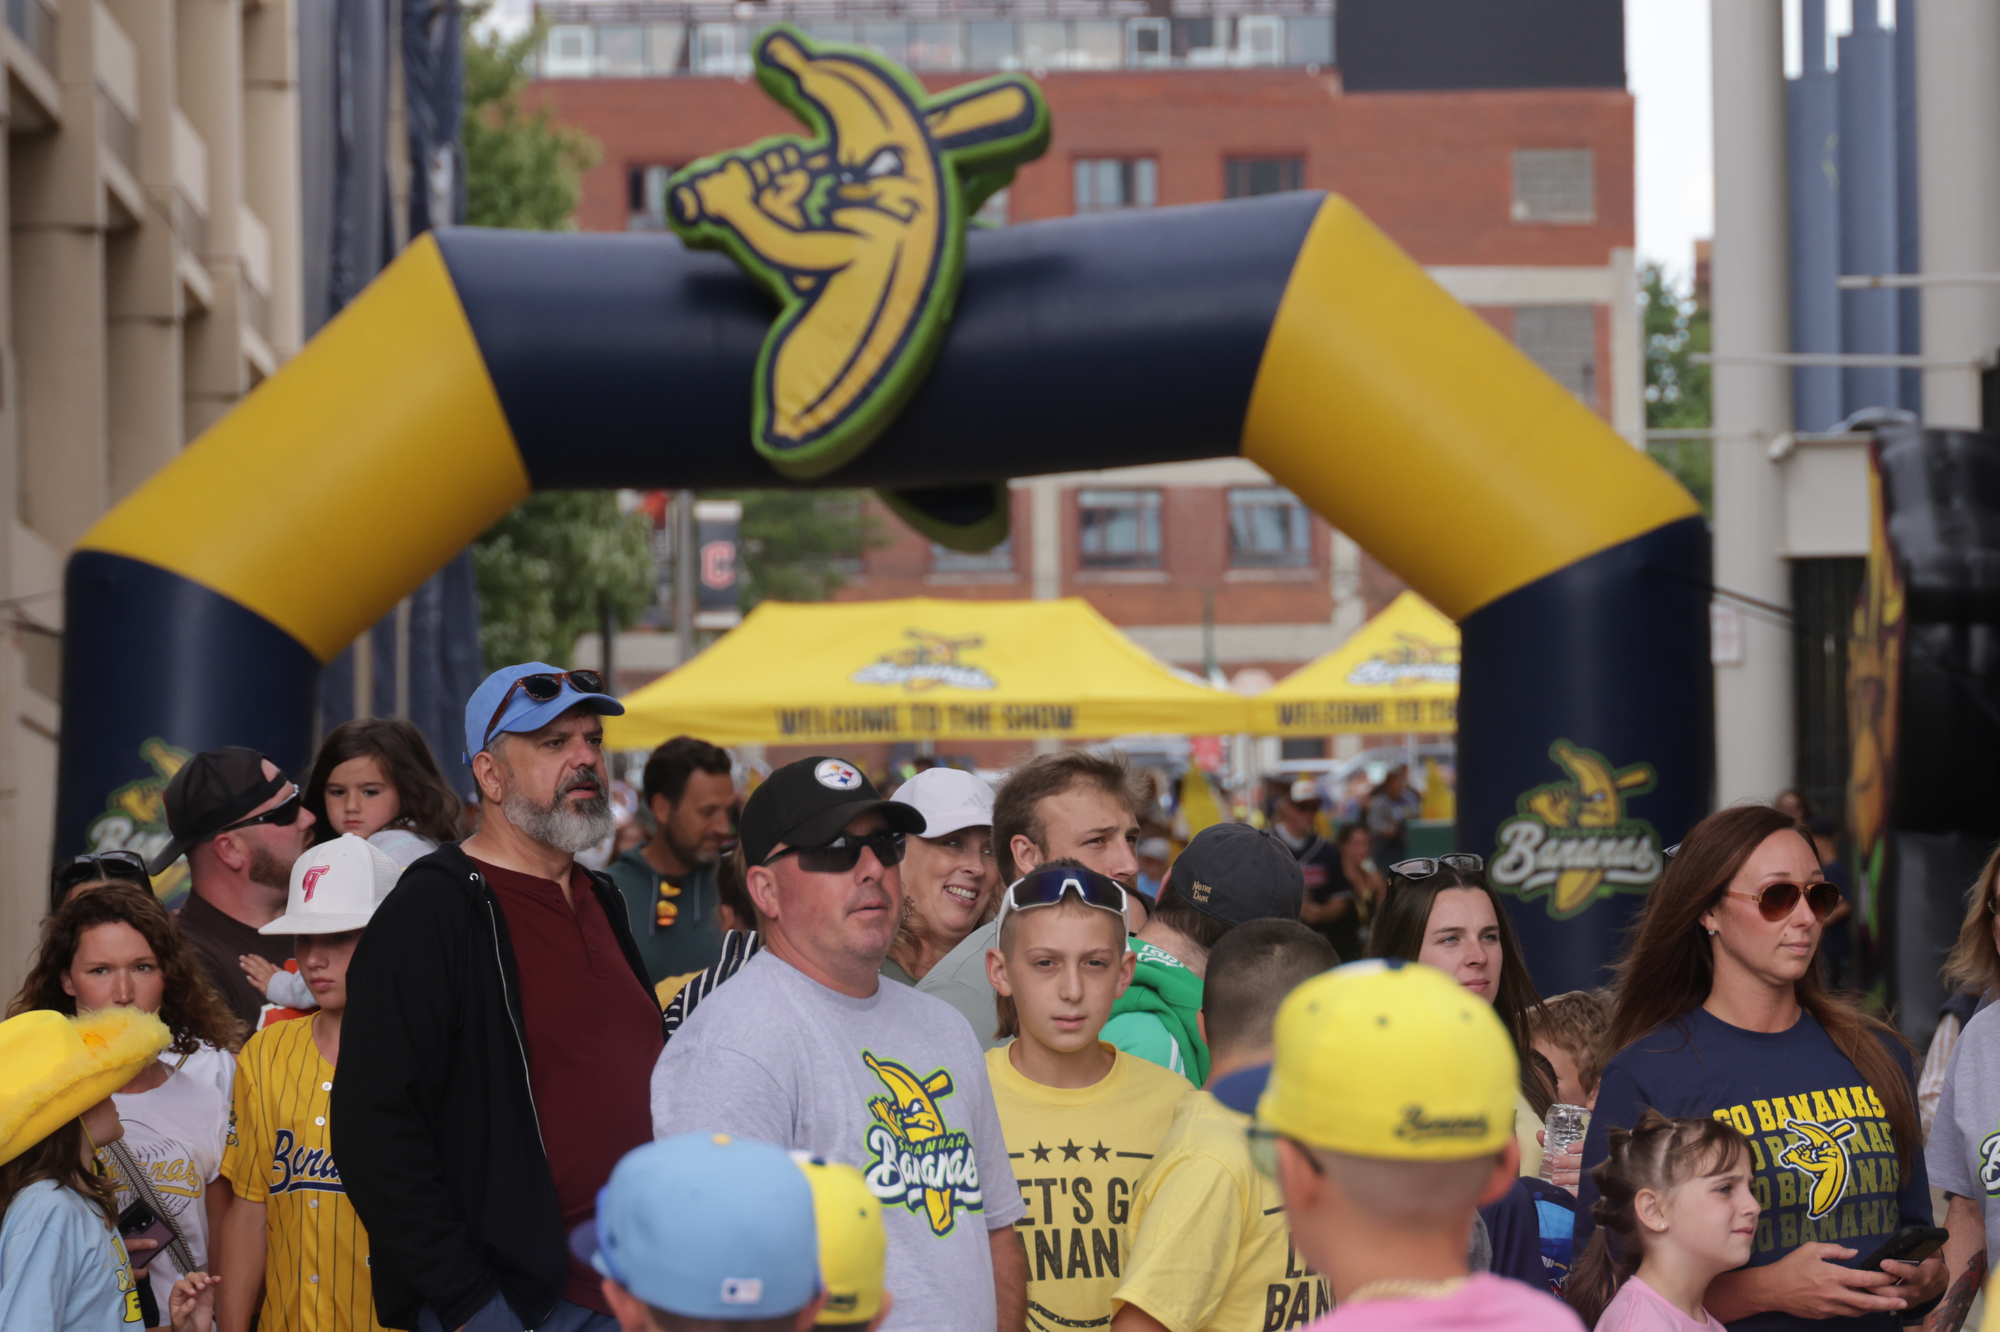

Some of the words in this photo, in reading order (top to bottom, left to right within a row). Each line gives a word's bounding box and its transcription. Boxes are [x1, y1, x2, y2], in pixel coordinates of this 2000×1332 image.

[701, 540, 736, 590] C
[909, 703, 942, 731] TO
[1491, 820, 1664, 892] Bananas
[1752, 1086, 1886, 1132] BANANAS
[865, 1128, 982, 1206] Bananas
[1014, 1176, 1094, 1226] ET'S
[1107, 1177, 1139, 1225] G
